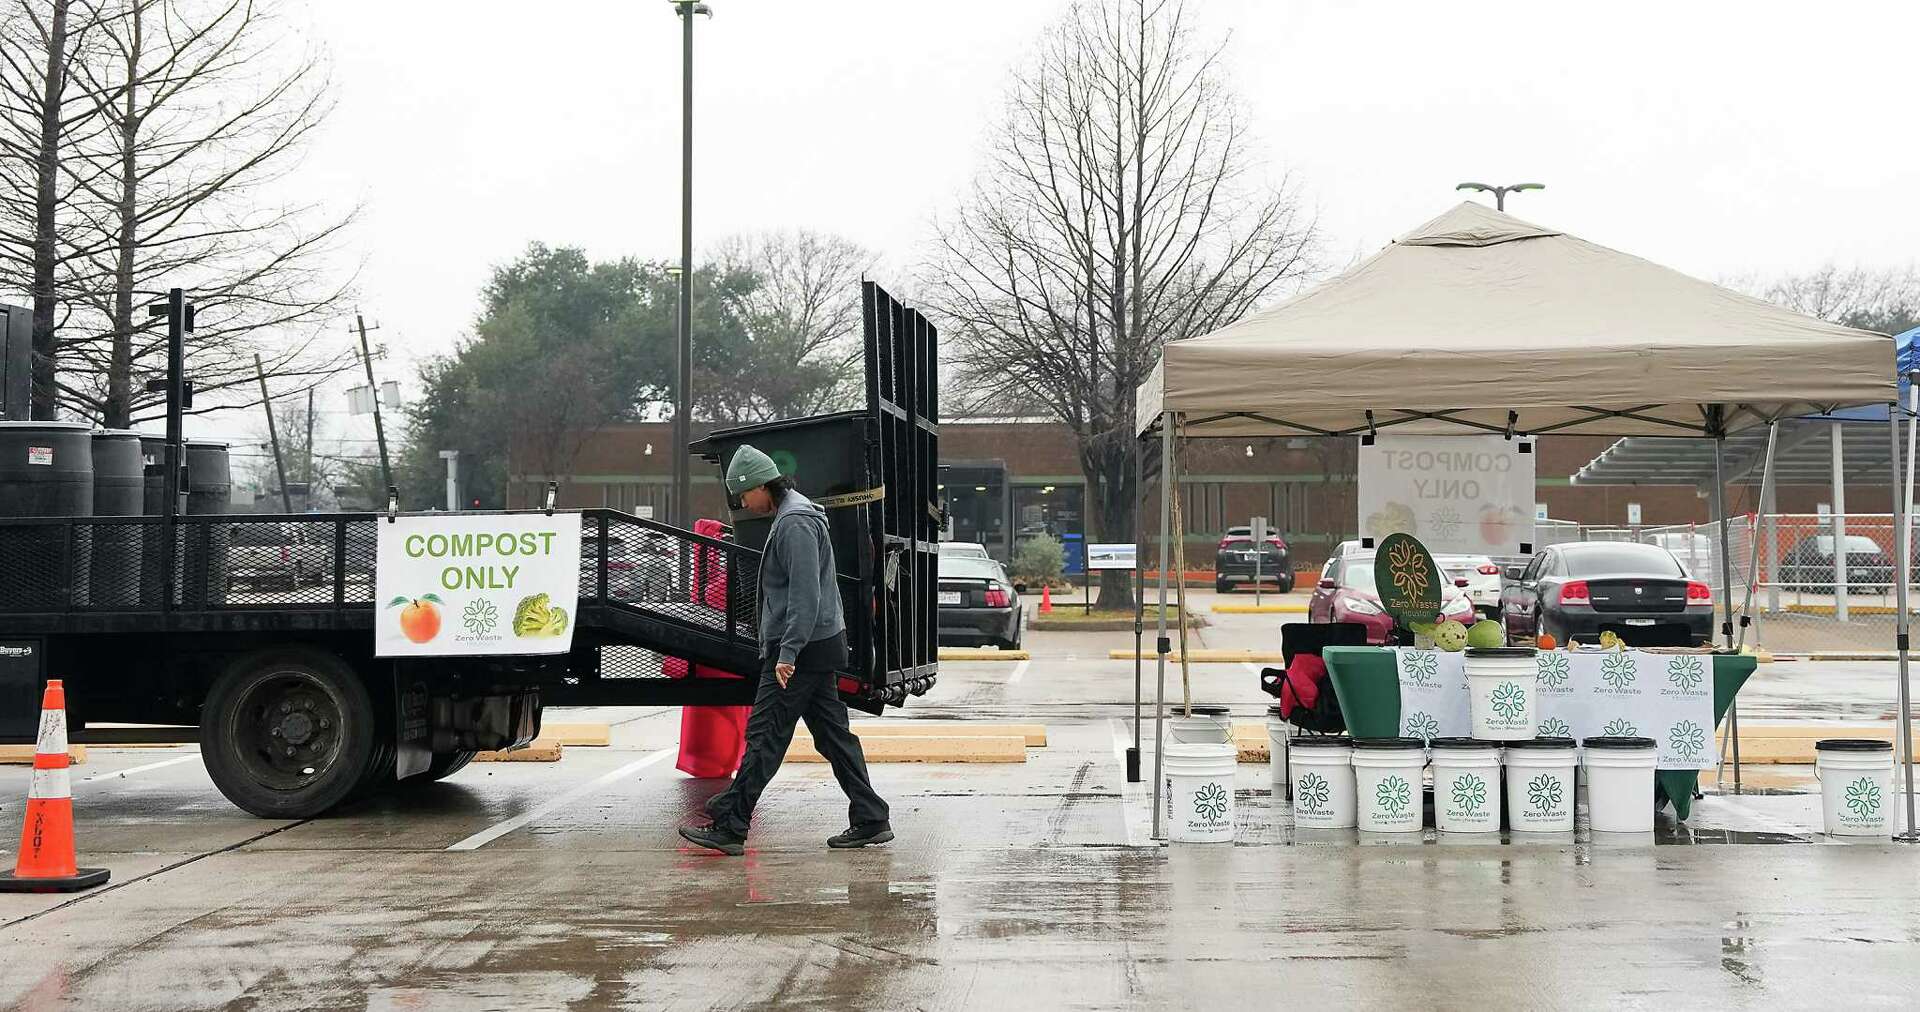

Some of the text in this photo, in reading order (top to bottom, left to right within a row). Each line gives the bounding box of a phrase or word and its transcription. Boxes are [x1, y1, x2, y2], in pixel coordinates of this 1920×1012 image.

[405, 532, 557, 558] COMPOST
[441, 565, 520, 590] ONLY
[1390, 598, 1439, 609] Zero Waste
[1593, 686, 1642, 695] Zero Waste
[1660, 688, 1680, 696] Zero
[1663, 755, 1681, 763] Zero
